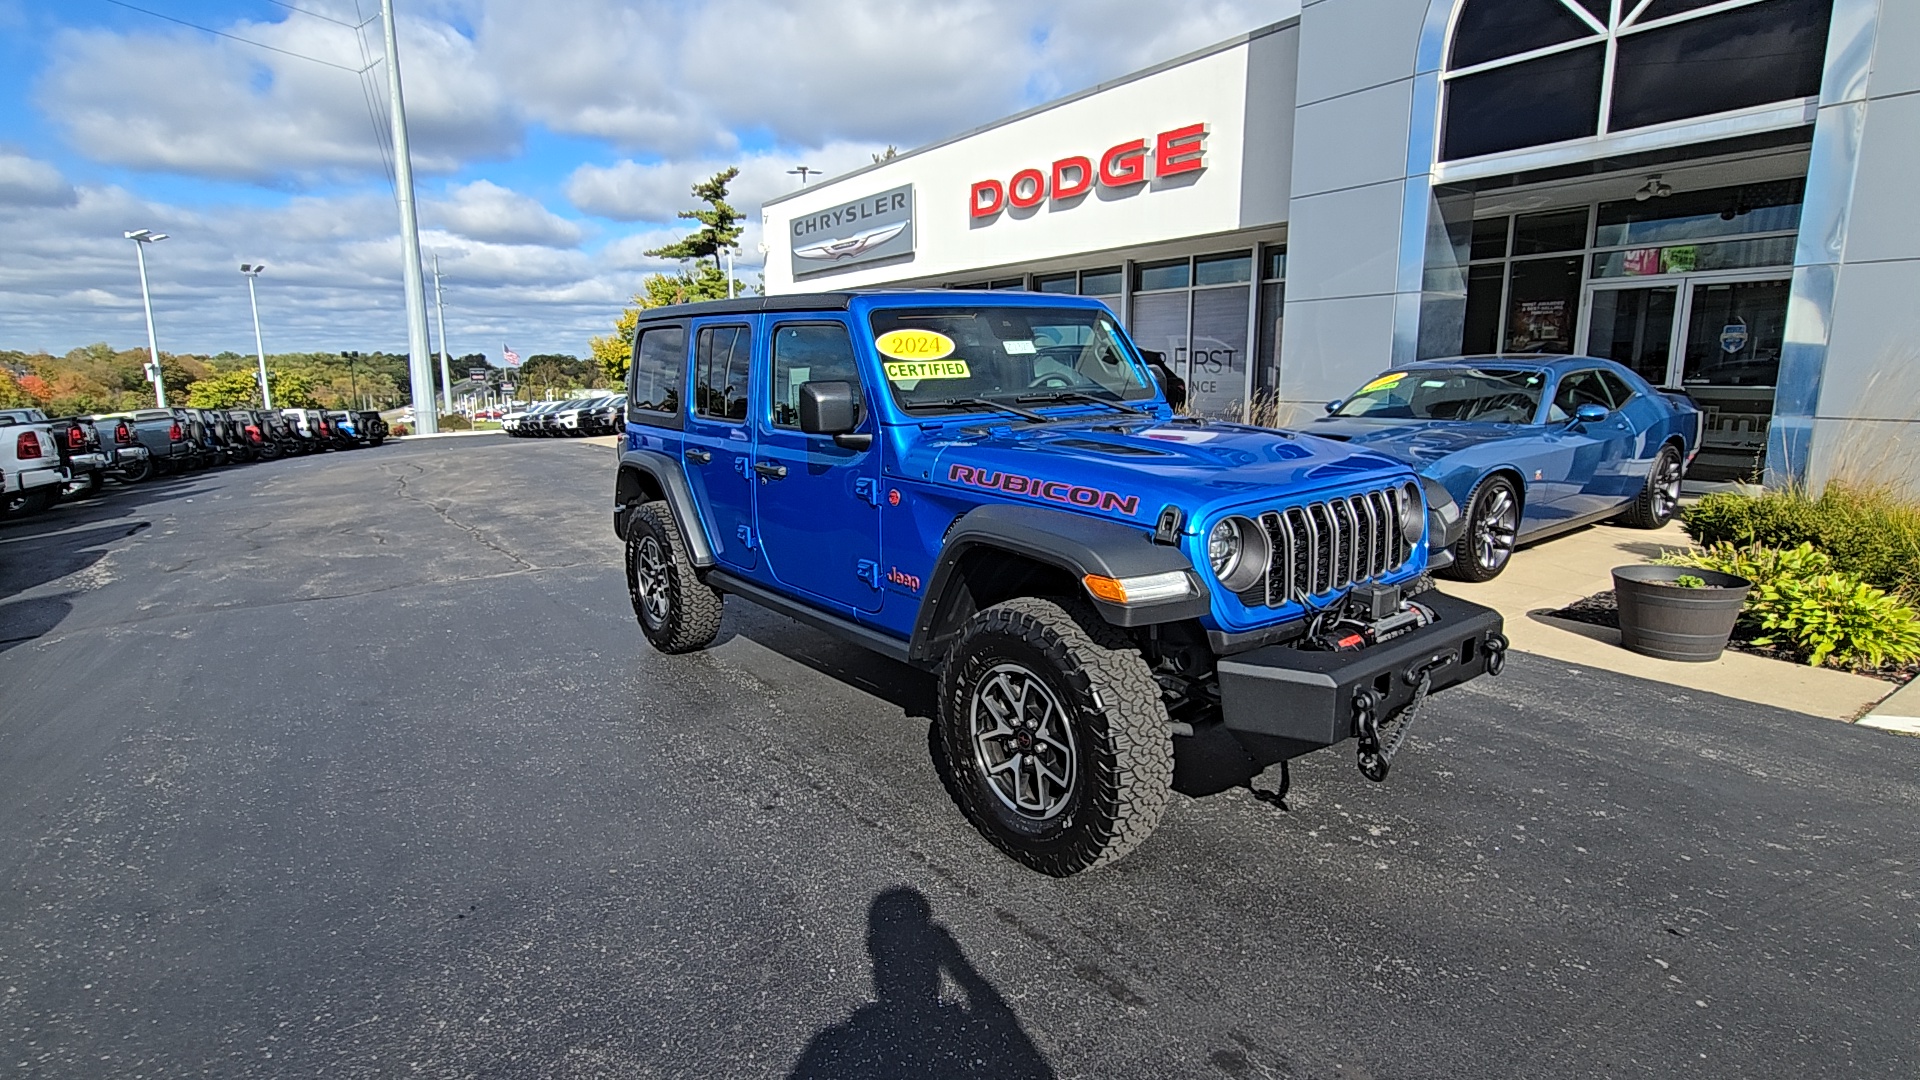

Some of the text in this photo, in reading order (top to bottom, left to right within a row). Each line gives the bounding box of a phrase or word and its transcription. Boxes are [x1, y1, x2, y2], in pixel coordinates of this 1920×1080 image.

[970, 122, 1208, 218] DODGE
[794, 192, 906, 237] CHRYSLER
[892, 336, 941, 354] 2024
[887, 362, 965, 377] CERTIFIED
[949, 464, 1140, 516] RUBICON
[886, 566, 920, 593] Jeep
